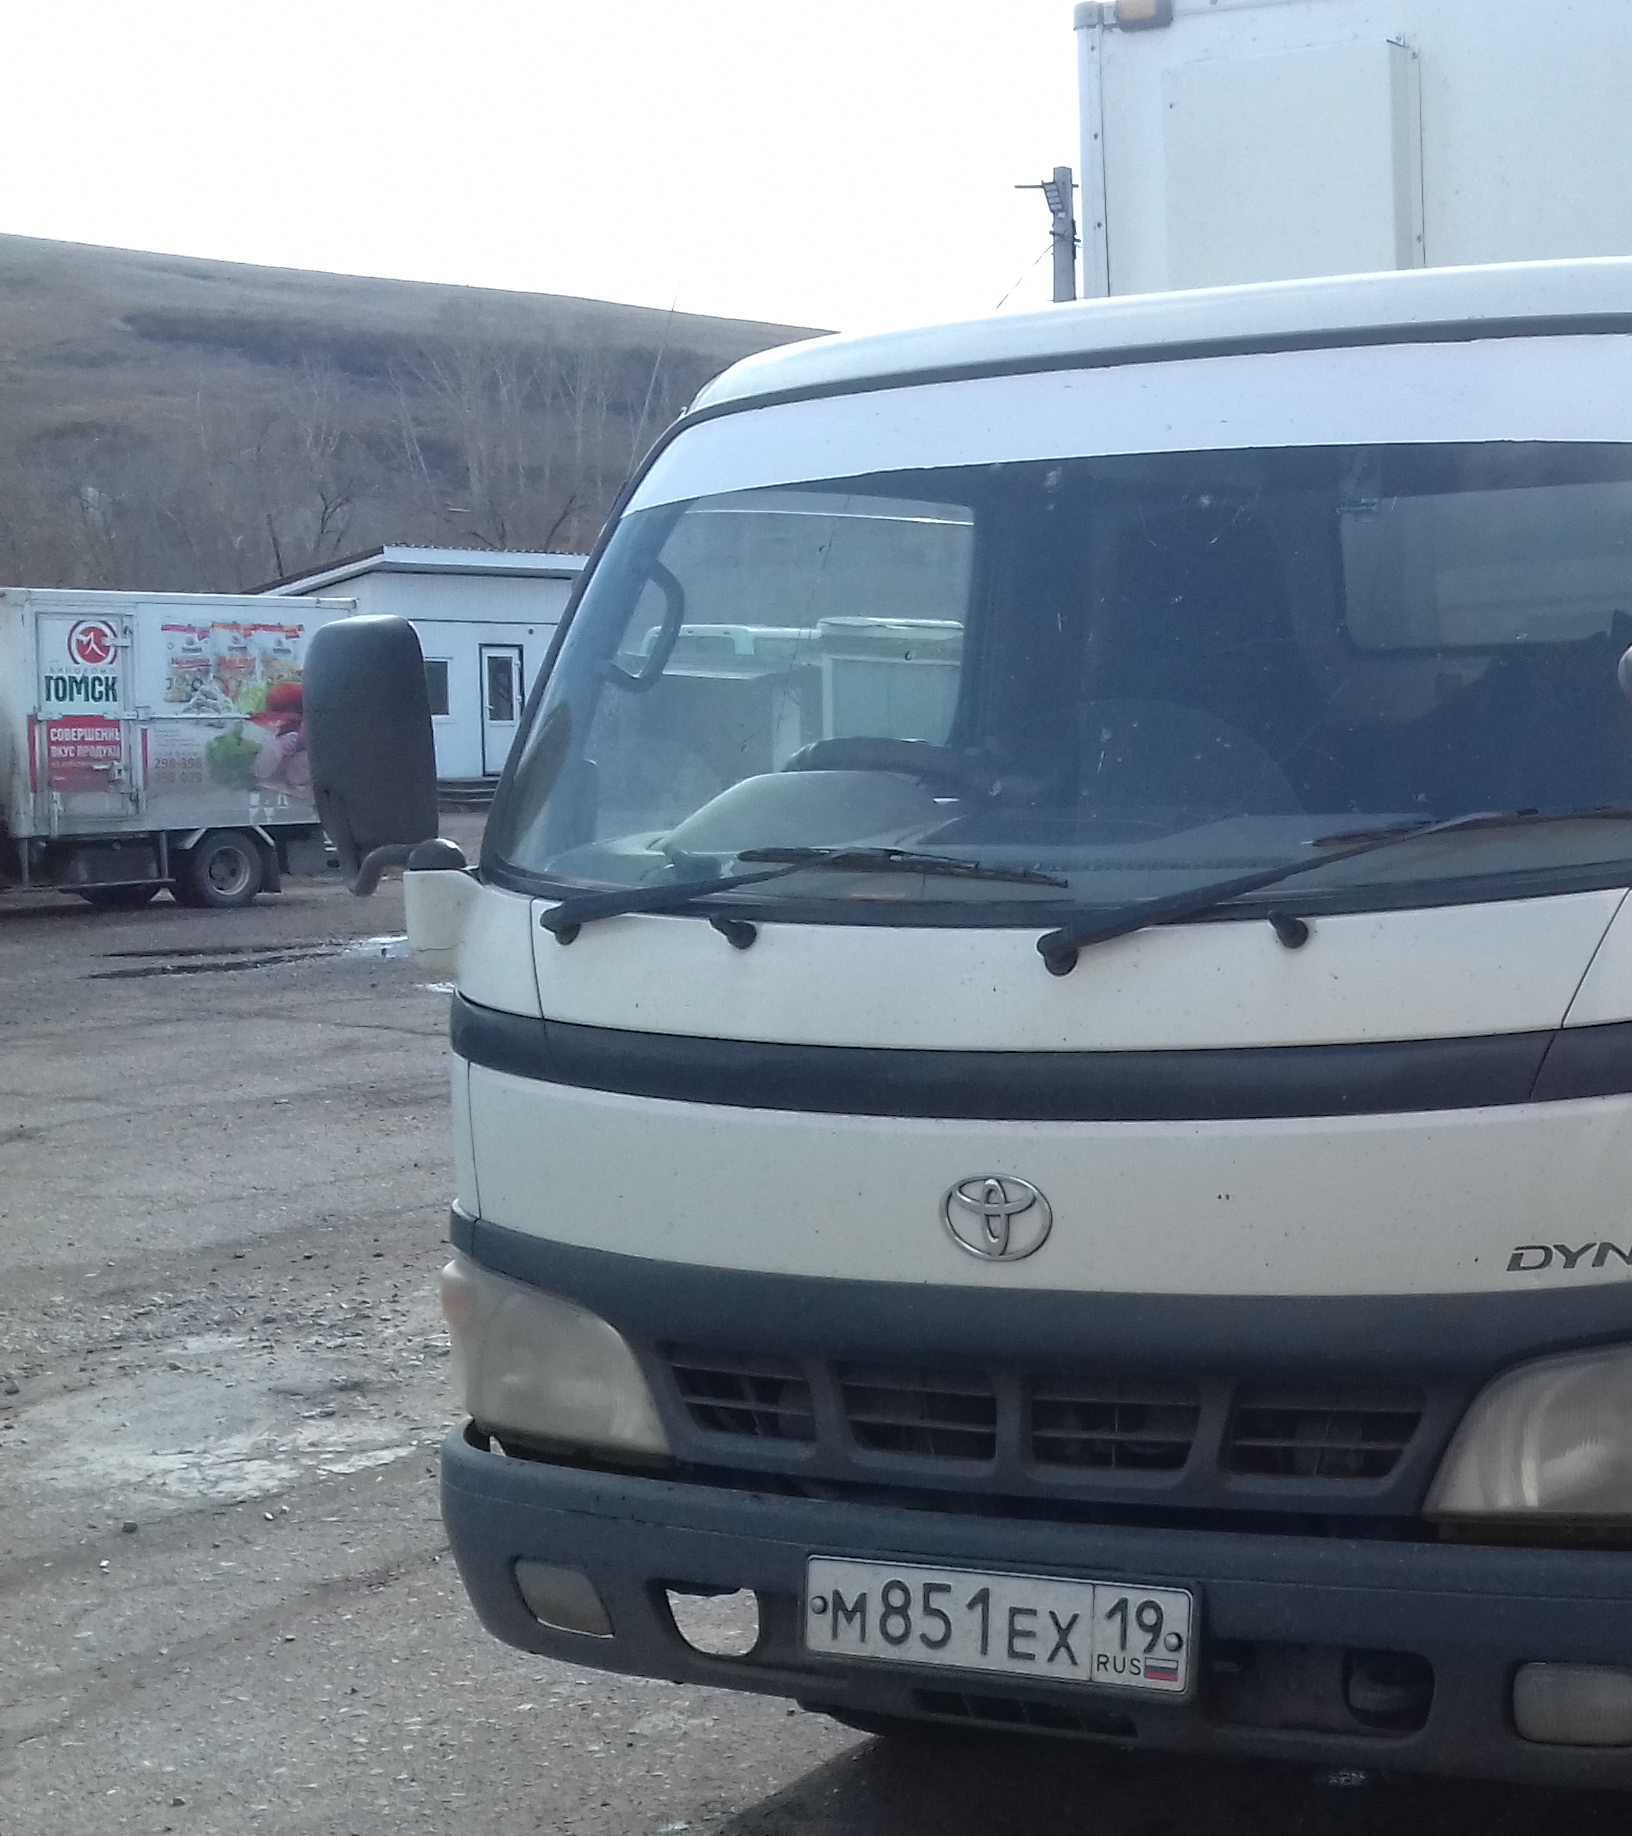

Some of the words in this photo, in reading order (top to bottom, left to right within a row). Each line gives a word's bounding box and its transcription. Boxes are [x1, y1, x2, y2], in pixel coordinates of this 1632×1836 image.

[44, 675, 118, 702] ТОМСК
[50, 745, 76, 758] ВКУС
[1105, 1596, 1165, 1654] 19
[1096, 1654, 1142, 1677] RUS
